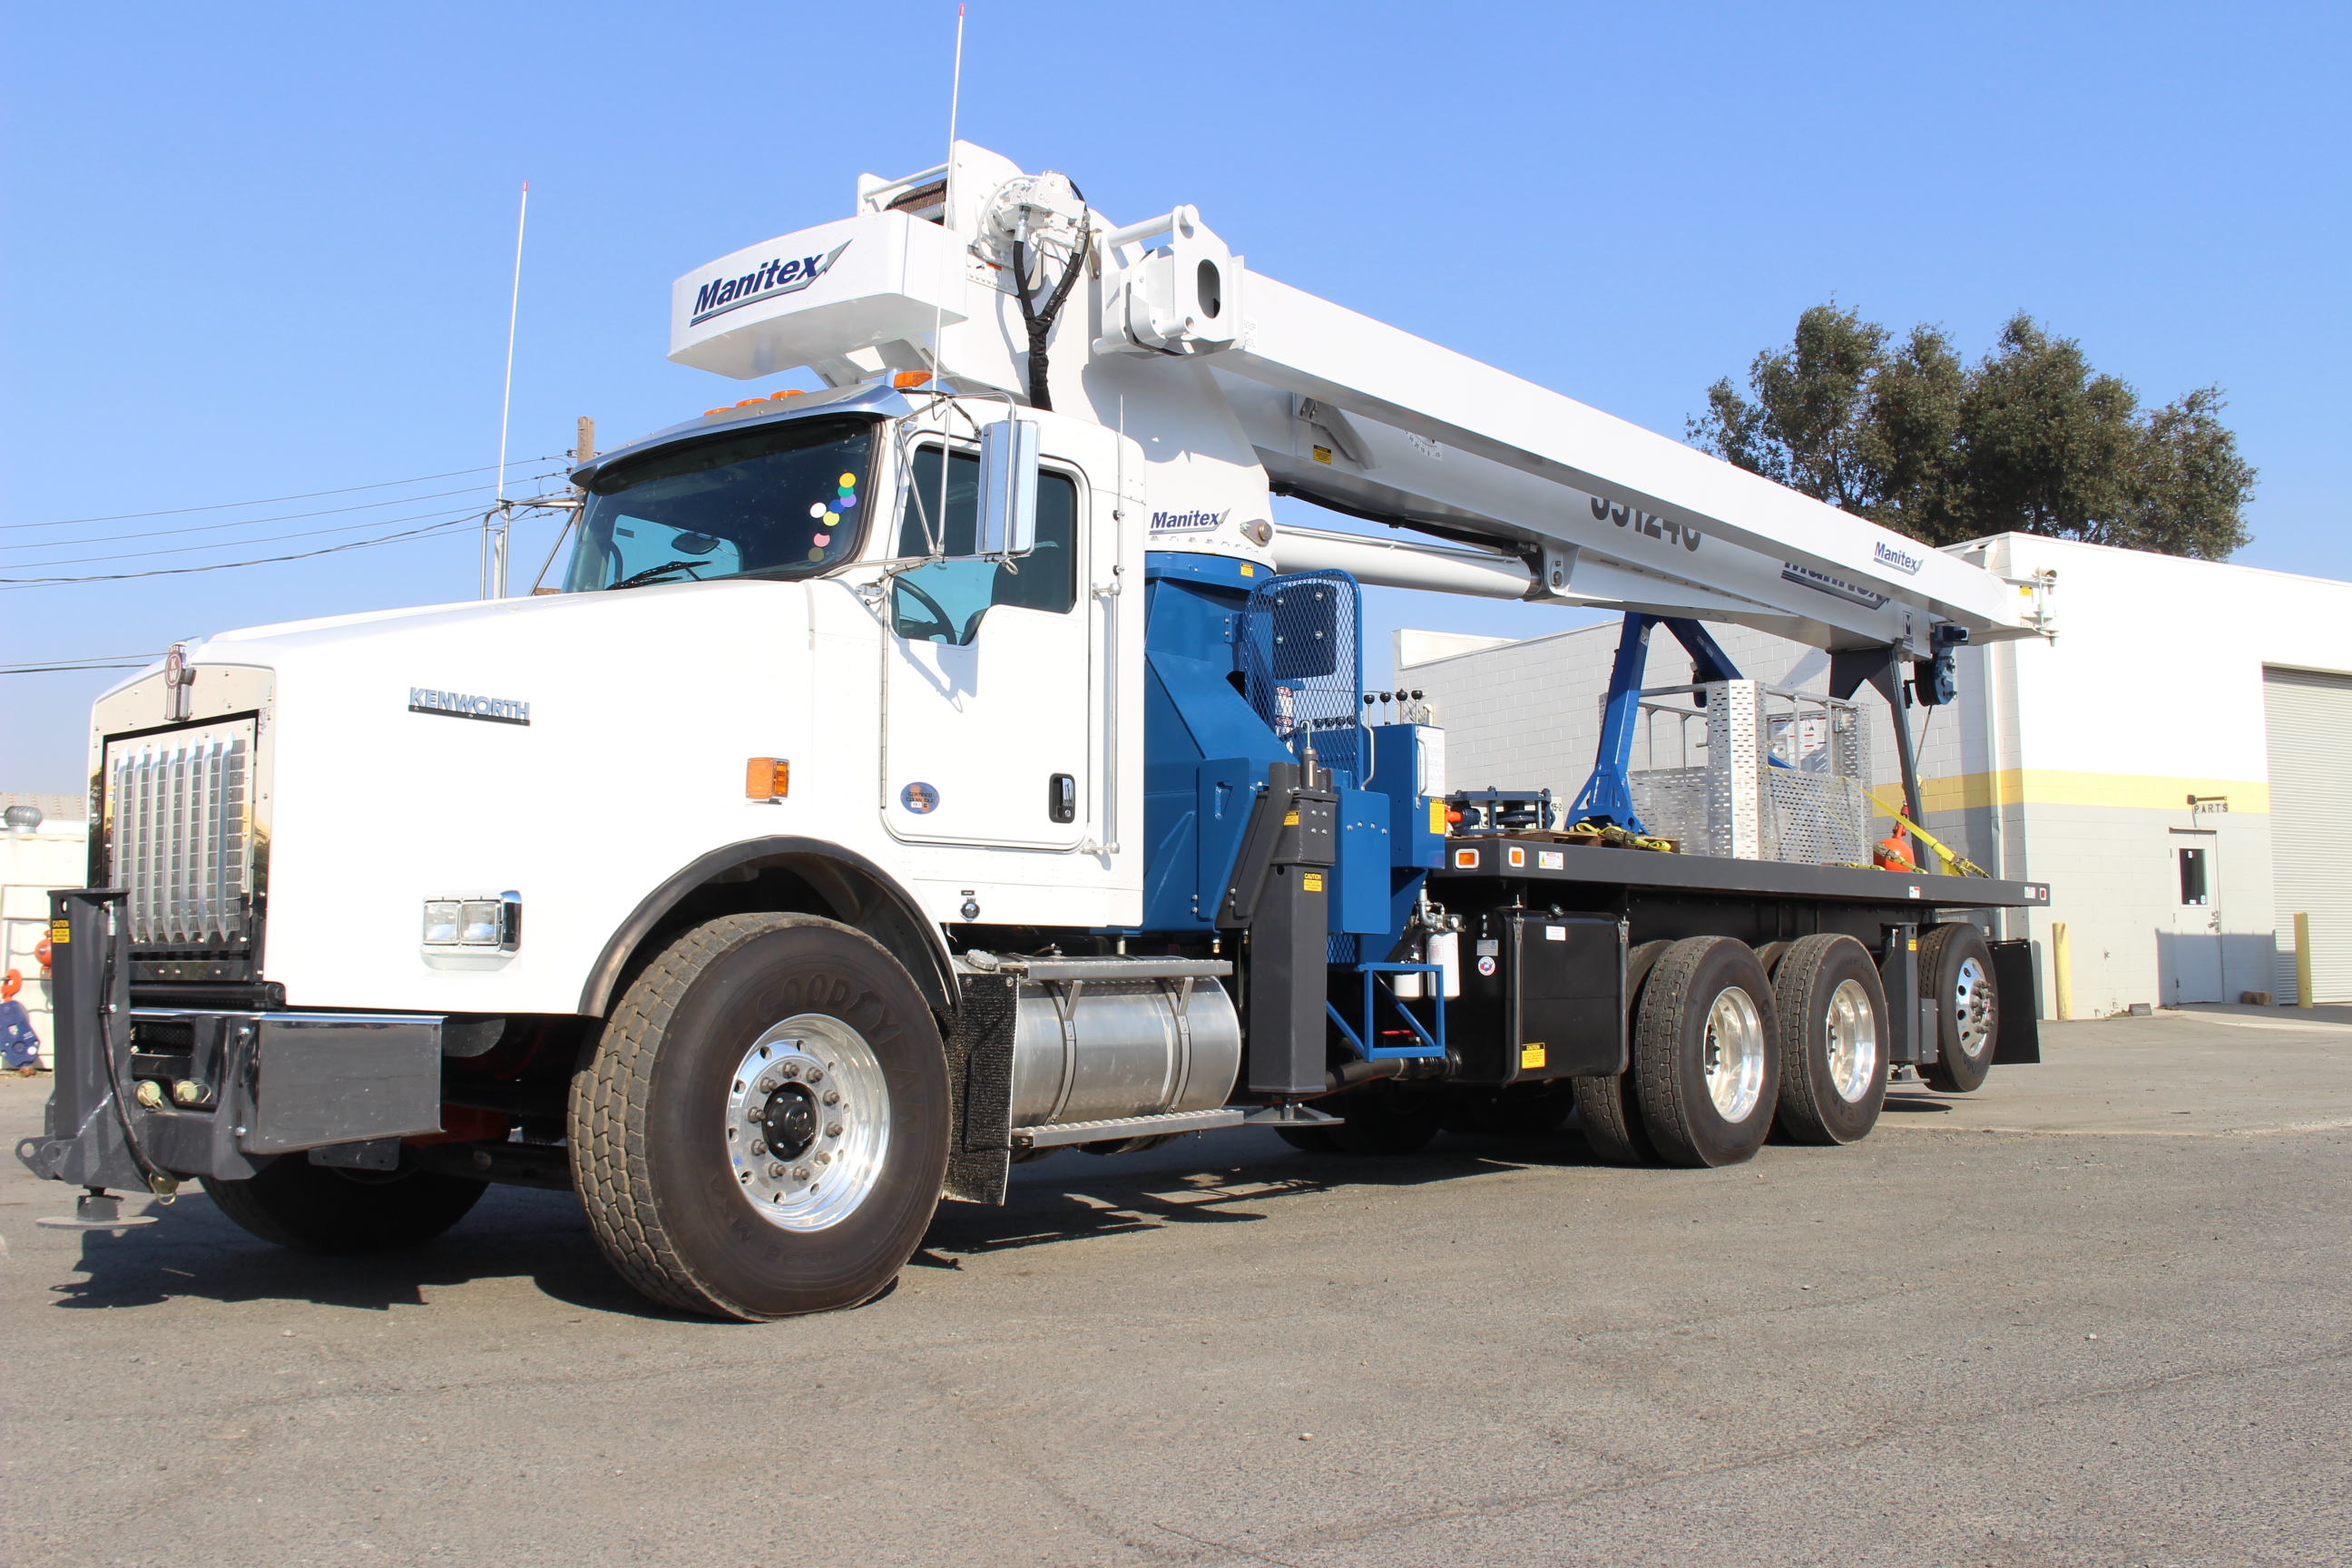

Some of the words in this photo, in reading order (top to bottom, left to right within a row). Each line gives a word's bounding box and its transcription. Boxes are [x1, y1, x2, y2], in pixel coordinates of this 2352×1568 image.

[693, 253, 824, 316] Manitex
[1151, 510, 1220, 529] Manitex
[1875, 541, 1917, 571] Manitex
[409, 687, 530, 720] KENWORTH
[2194, 803, 2229, 814] PARTS
[1304, 872, 1322, 880] CAUTION
[52, 919, 69, 928] CAUTION
